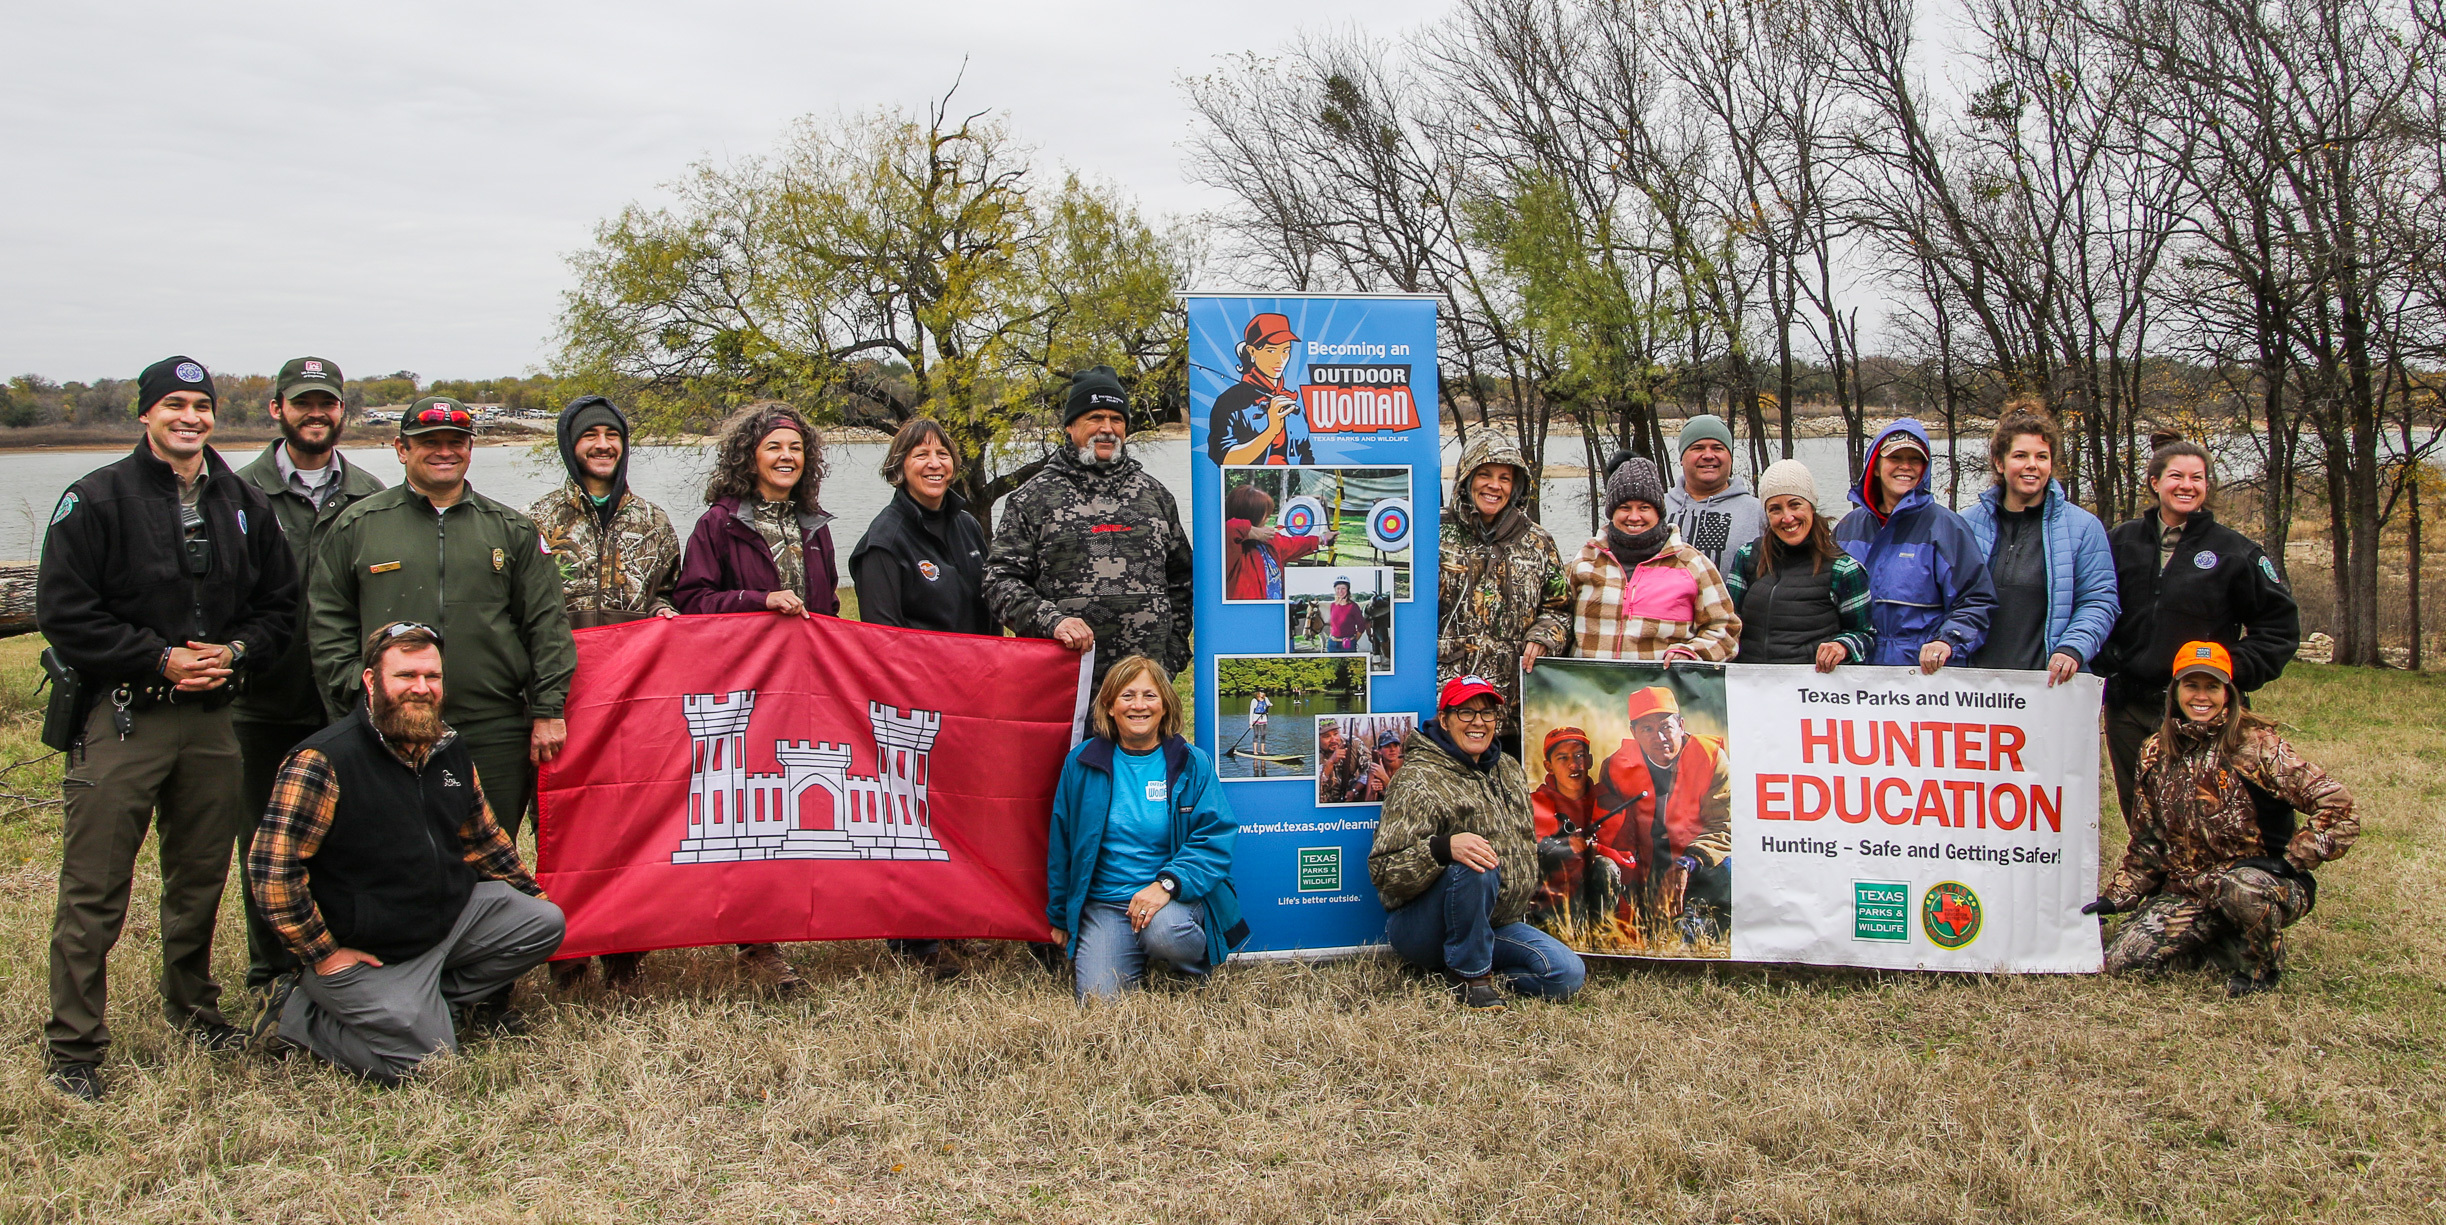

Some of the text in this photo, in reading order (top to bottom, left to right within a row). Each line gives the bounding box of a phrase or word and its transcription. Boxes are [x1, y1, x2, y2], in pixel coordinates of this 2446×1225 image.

[1307, 341, 1410, 359] Becoming an
[1313, 368, 1407, 383] OUTDOOR
[1312, 390, 1409, 429] WOMAN
[1797, 688, 2027, 709] Texas Parks and Wildlife
[1800, 718, 2026, 772] HUNTER
[1756, 773, 2063, 833] EDUCATION
[1761, 835, 1838, 858] Hunting
[1859, 839, 1902, 857] Safe
[1907, 842, 1940, 859] and
[1945, 844, 2010, 866] Getting
[2012, 846, 2062, 865] Safer!
[1303, 854, 1337, 863] TEXAS
[1858, 890, 1904, 902] TEXAS
[1934, 884, 1968, 897] TEXAS
[1278, 894, 1361, 905] Life's better outside.
[1859, 907, 1904, 917] PARKS &
[1858, 923, 1904, 933] WILDLIFE
